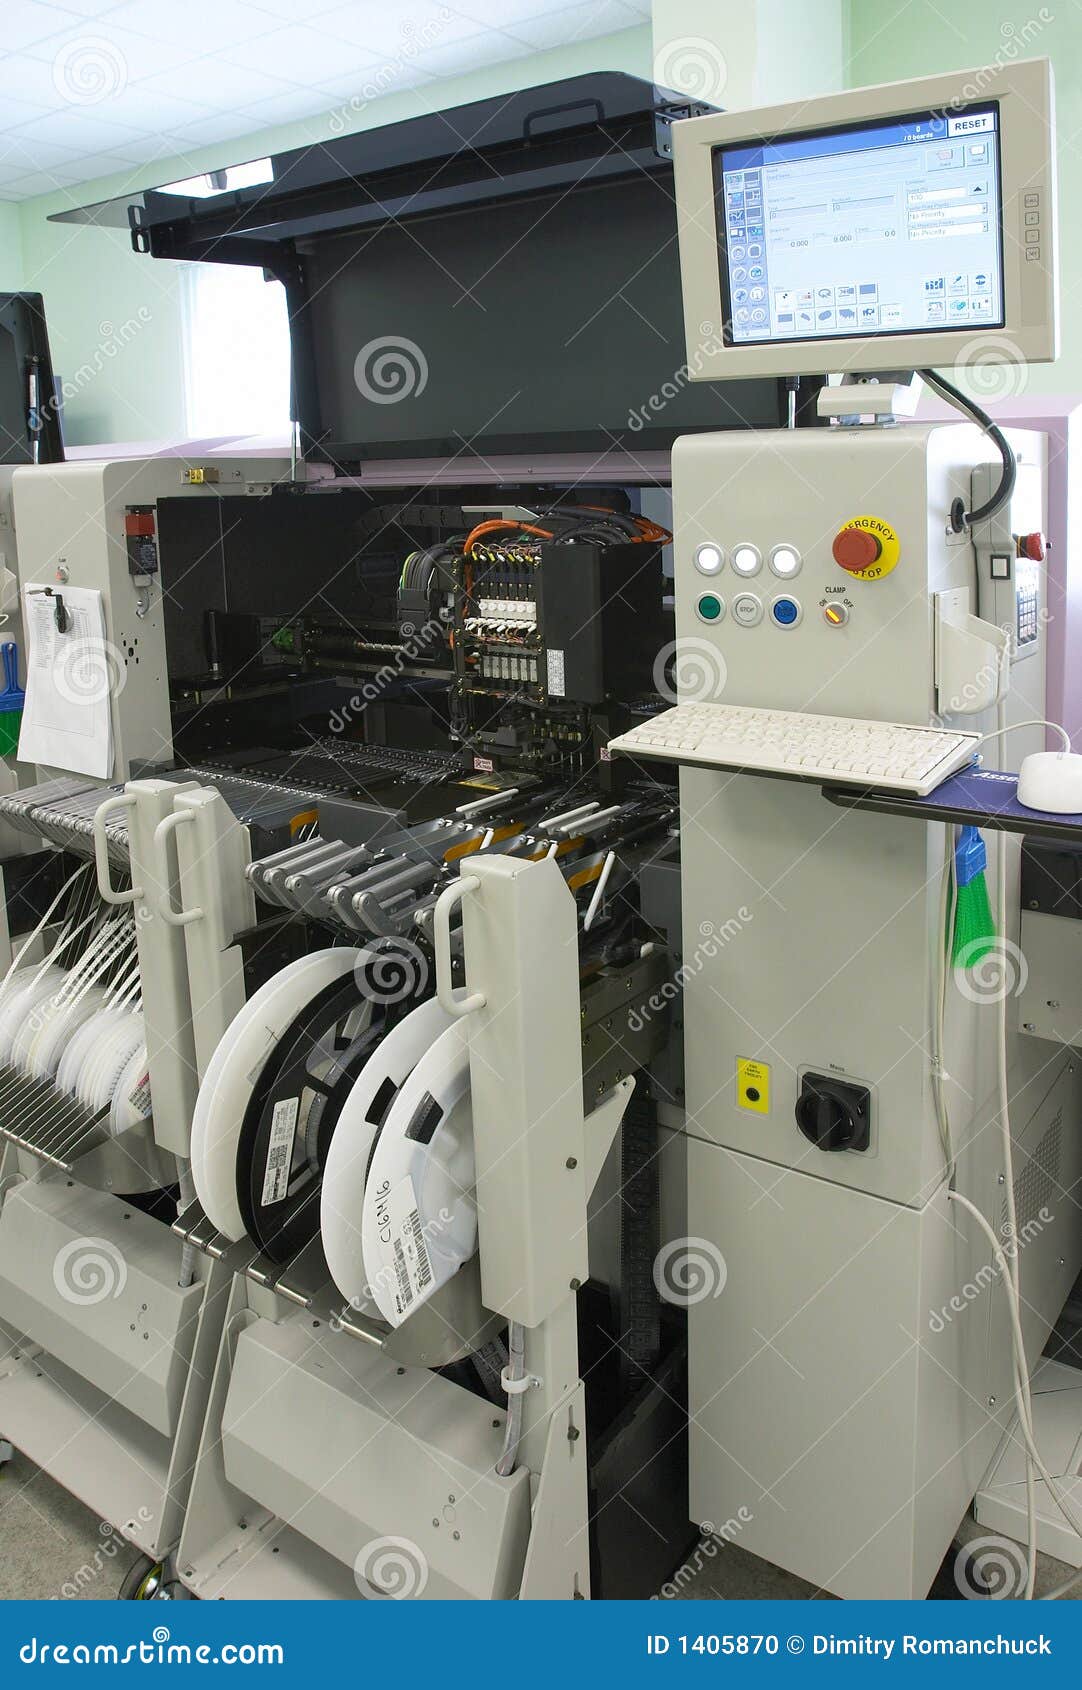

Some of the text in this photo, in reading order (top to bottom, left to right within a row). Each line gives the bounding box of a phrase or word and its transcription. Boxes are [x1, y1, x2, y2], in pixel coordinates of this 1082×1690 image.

[954, 118, 987, 131] RESET
[913, 132, 934, 140] boards
[844, 519, 895, 541] ERGENCY
[825, 586, 847, 594] CLAMP
[819, 598, 855, 608] ON OFF
